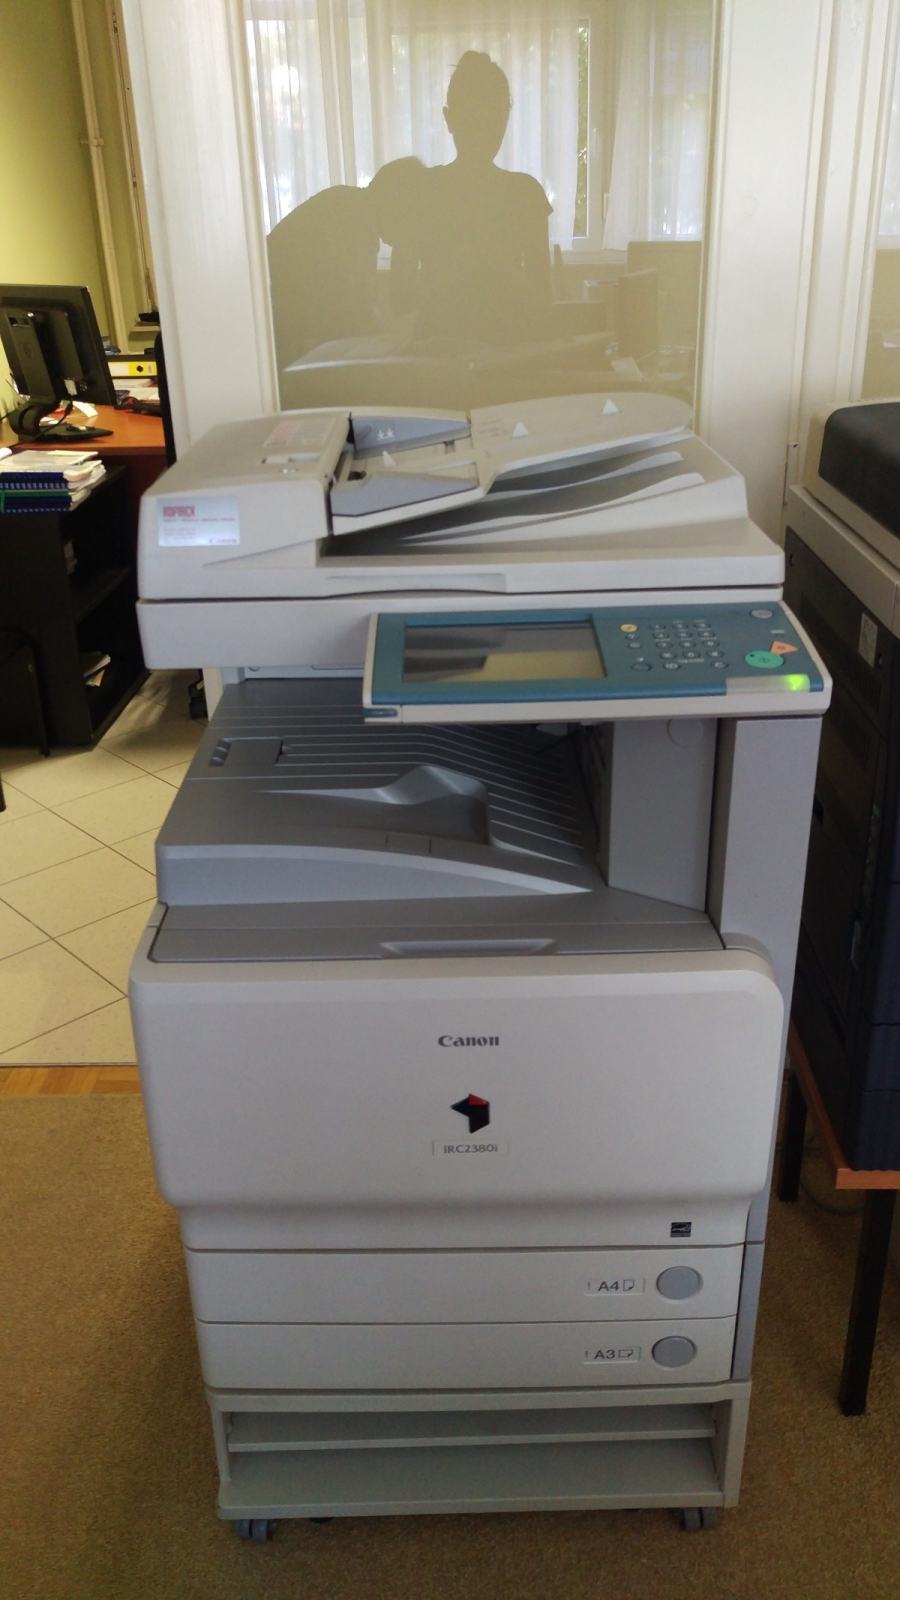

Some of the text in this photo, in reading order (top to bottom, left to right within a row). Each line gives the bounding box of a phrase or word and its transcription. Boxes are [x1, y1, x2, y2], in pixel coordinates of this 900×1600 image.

[438, 1035, 499, 1047] Canon
[598, 1281, 619, 1291] A4
[594, 1349, 616, 1359] A3
